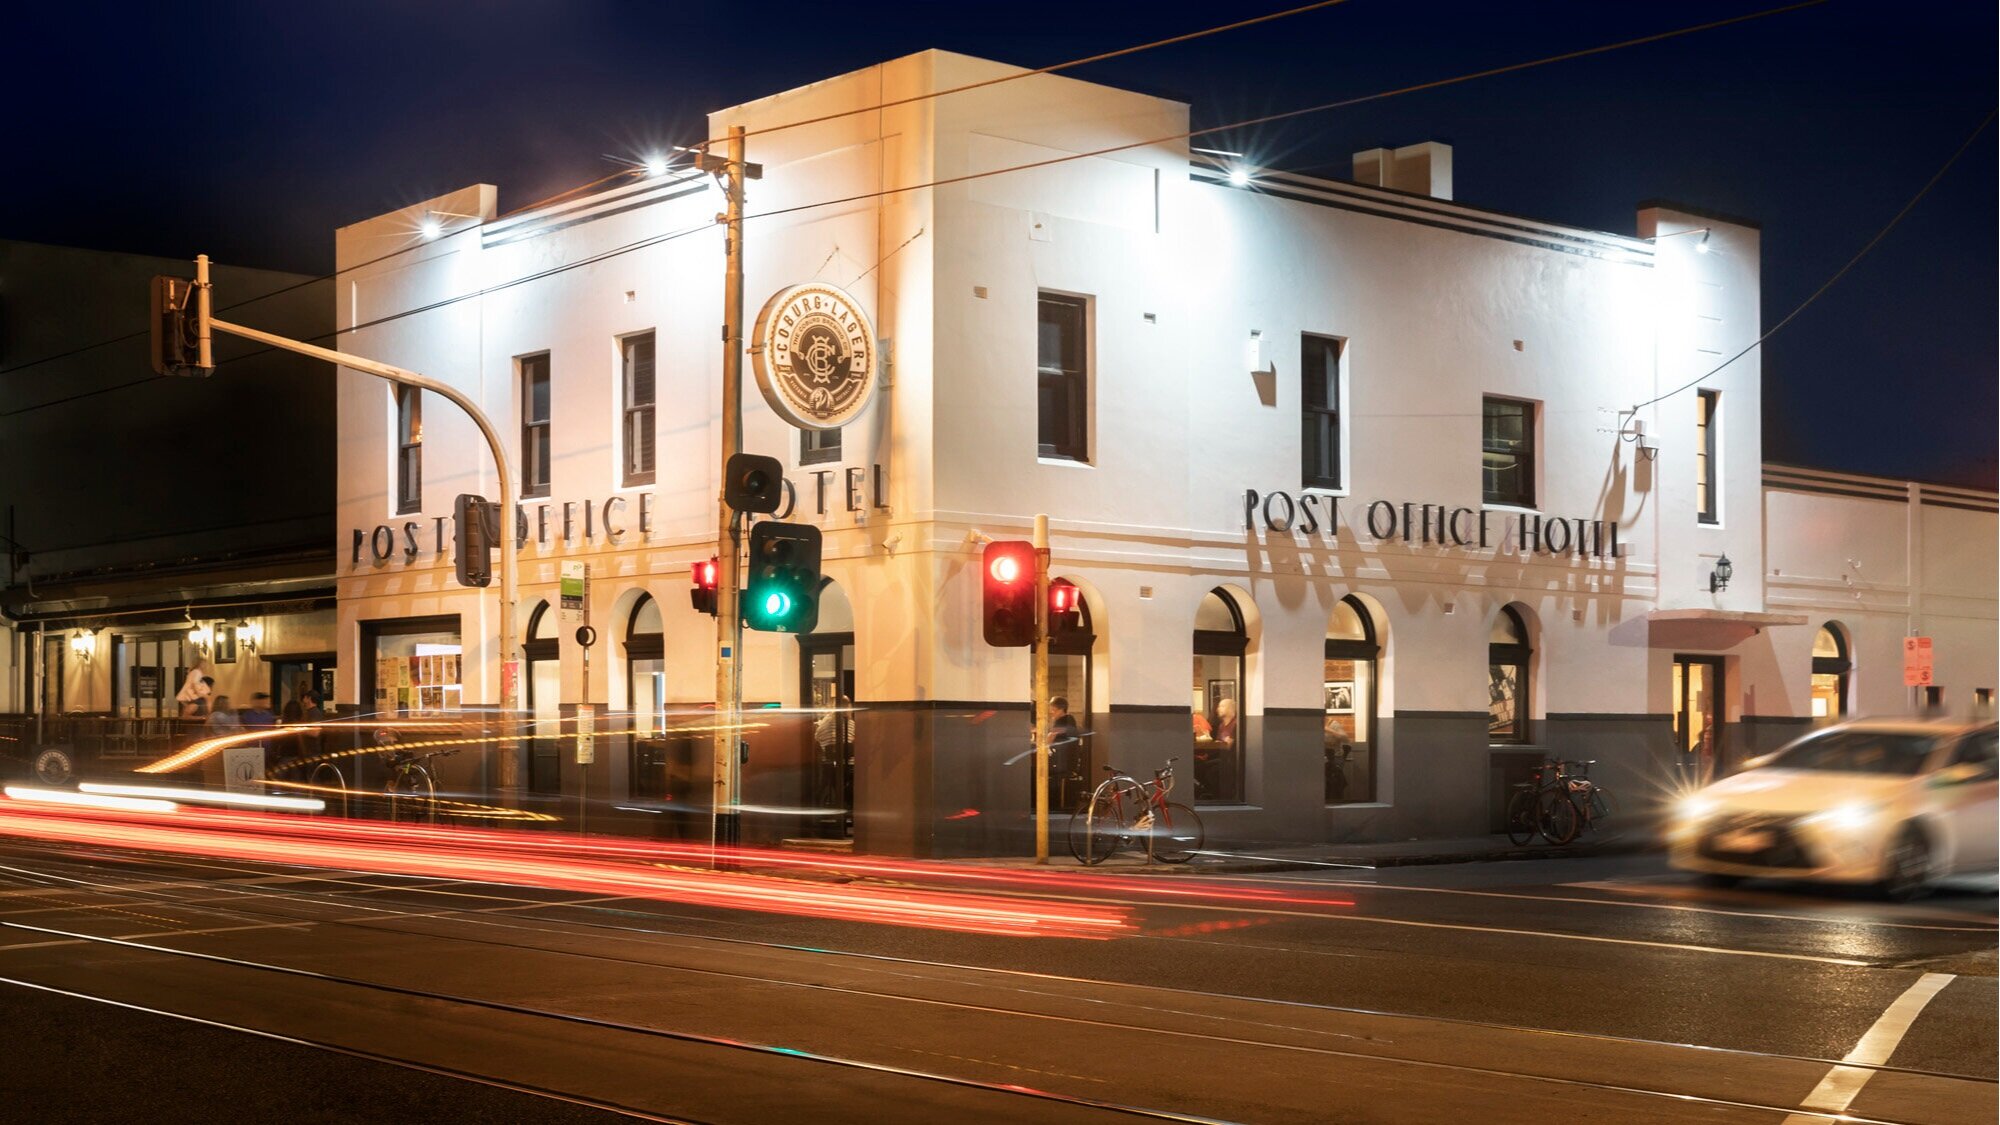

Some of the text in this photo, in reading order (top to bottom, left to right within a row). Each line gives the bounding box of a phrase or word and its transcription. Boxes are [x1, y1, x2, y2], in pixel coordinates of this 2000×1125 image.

[777, 295, 865, 359] COBURG LAGER
[352, 463, 893, 563] POST FFICE OTEL
[1245, 488, 1620, 558] POST OFFICE HOTEL
